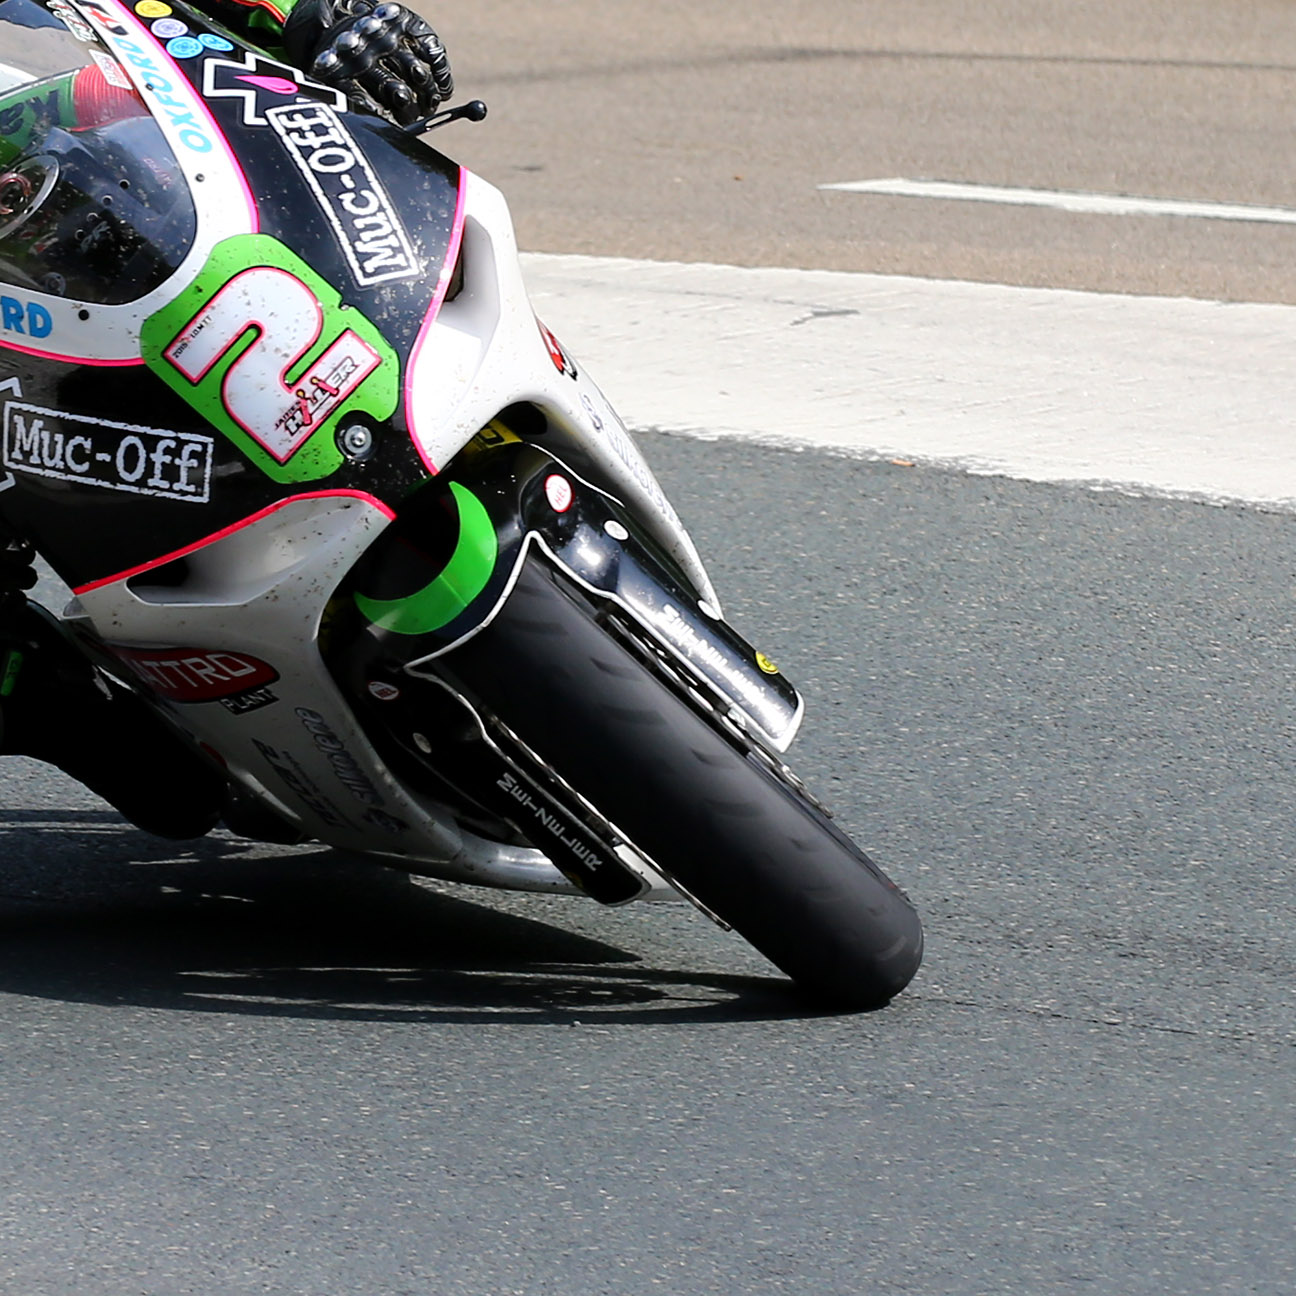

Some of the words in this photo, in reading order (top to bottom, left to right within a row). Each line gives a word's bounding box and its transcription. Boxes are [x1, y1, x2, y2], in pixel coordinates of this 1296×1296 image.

[112, 37, 213, 153] OXFORD
[278, 106, 405, 274] Muc-Off
[163, 266, 383, 466] 2
[11, 414, 203, 493] Muc-Off
[220, 688, 274, 712] PLANT
[496, 773, 603, 872] METZELER
